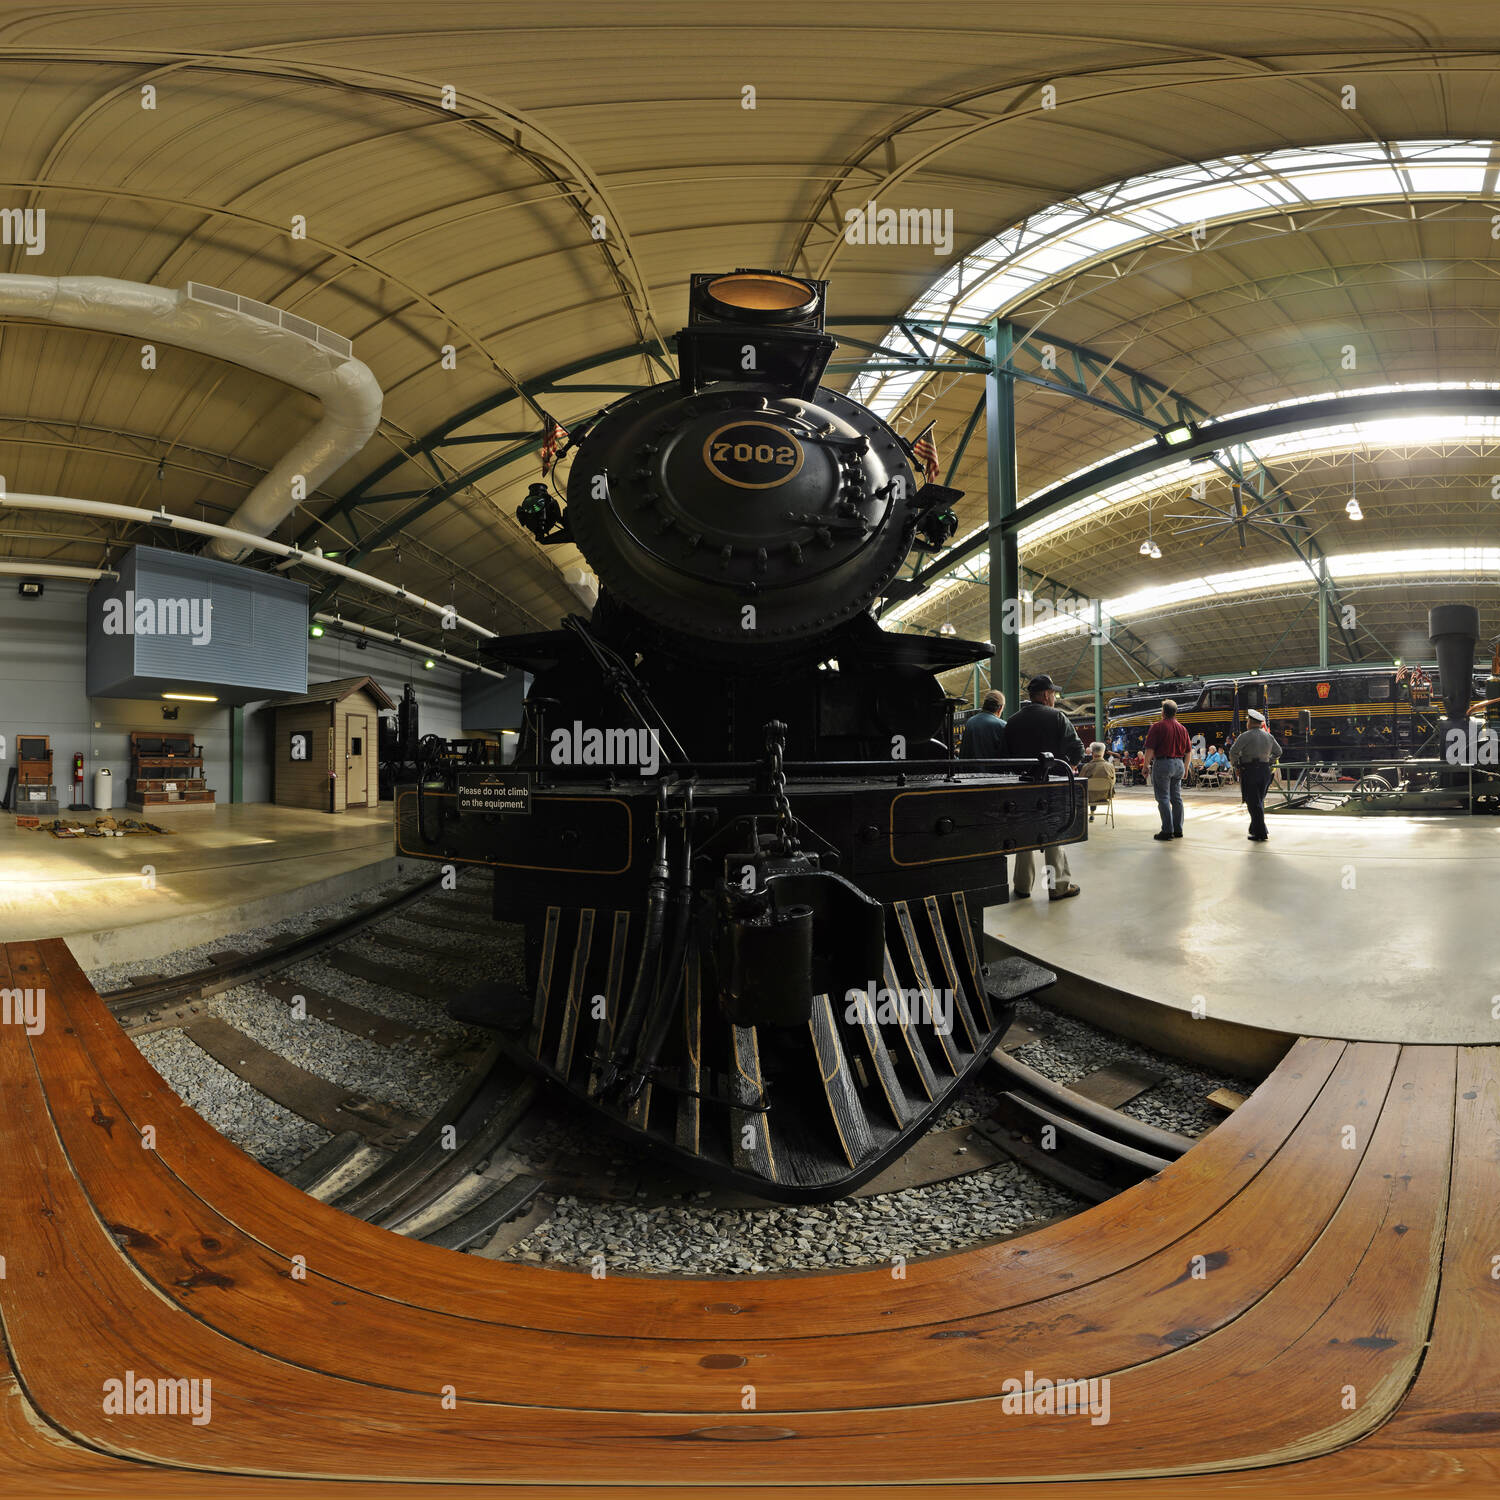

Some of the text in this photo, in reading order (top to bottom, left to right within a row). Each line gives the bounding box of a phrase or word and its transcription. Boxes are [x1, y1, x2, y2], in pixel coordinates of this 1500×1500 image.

[713, 443, 795, 466] 7002
[459, 786, 528, 797] Please do not climb
[461, 799, 525, 810] on the equipment.
